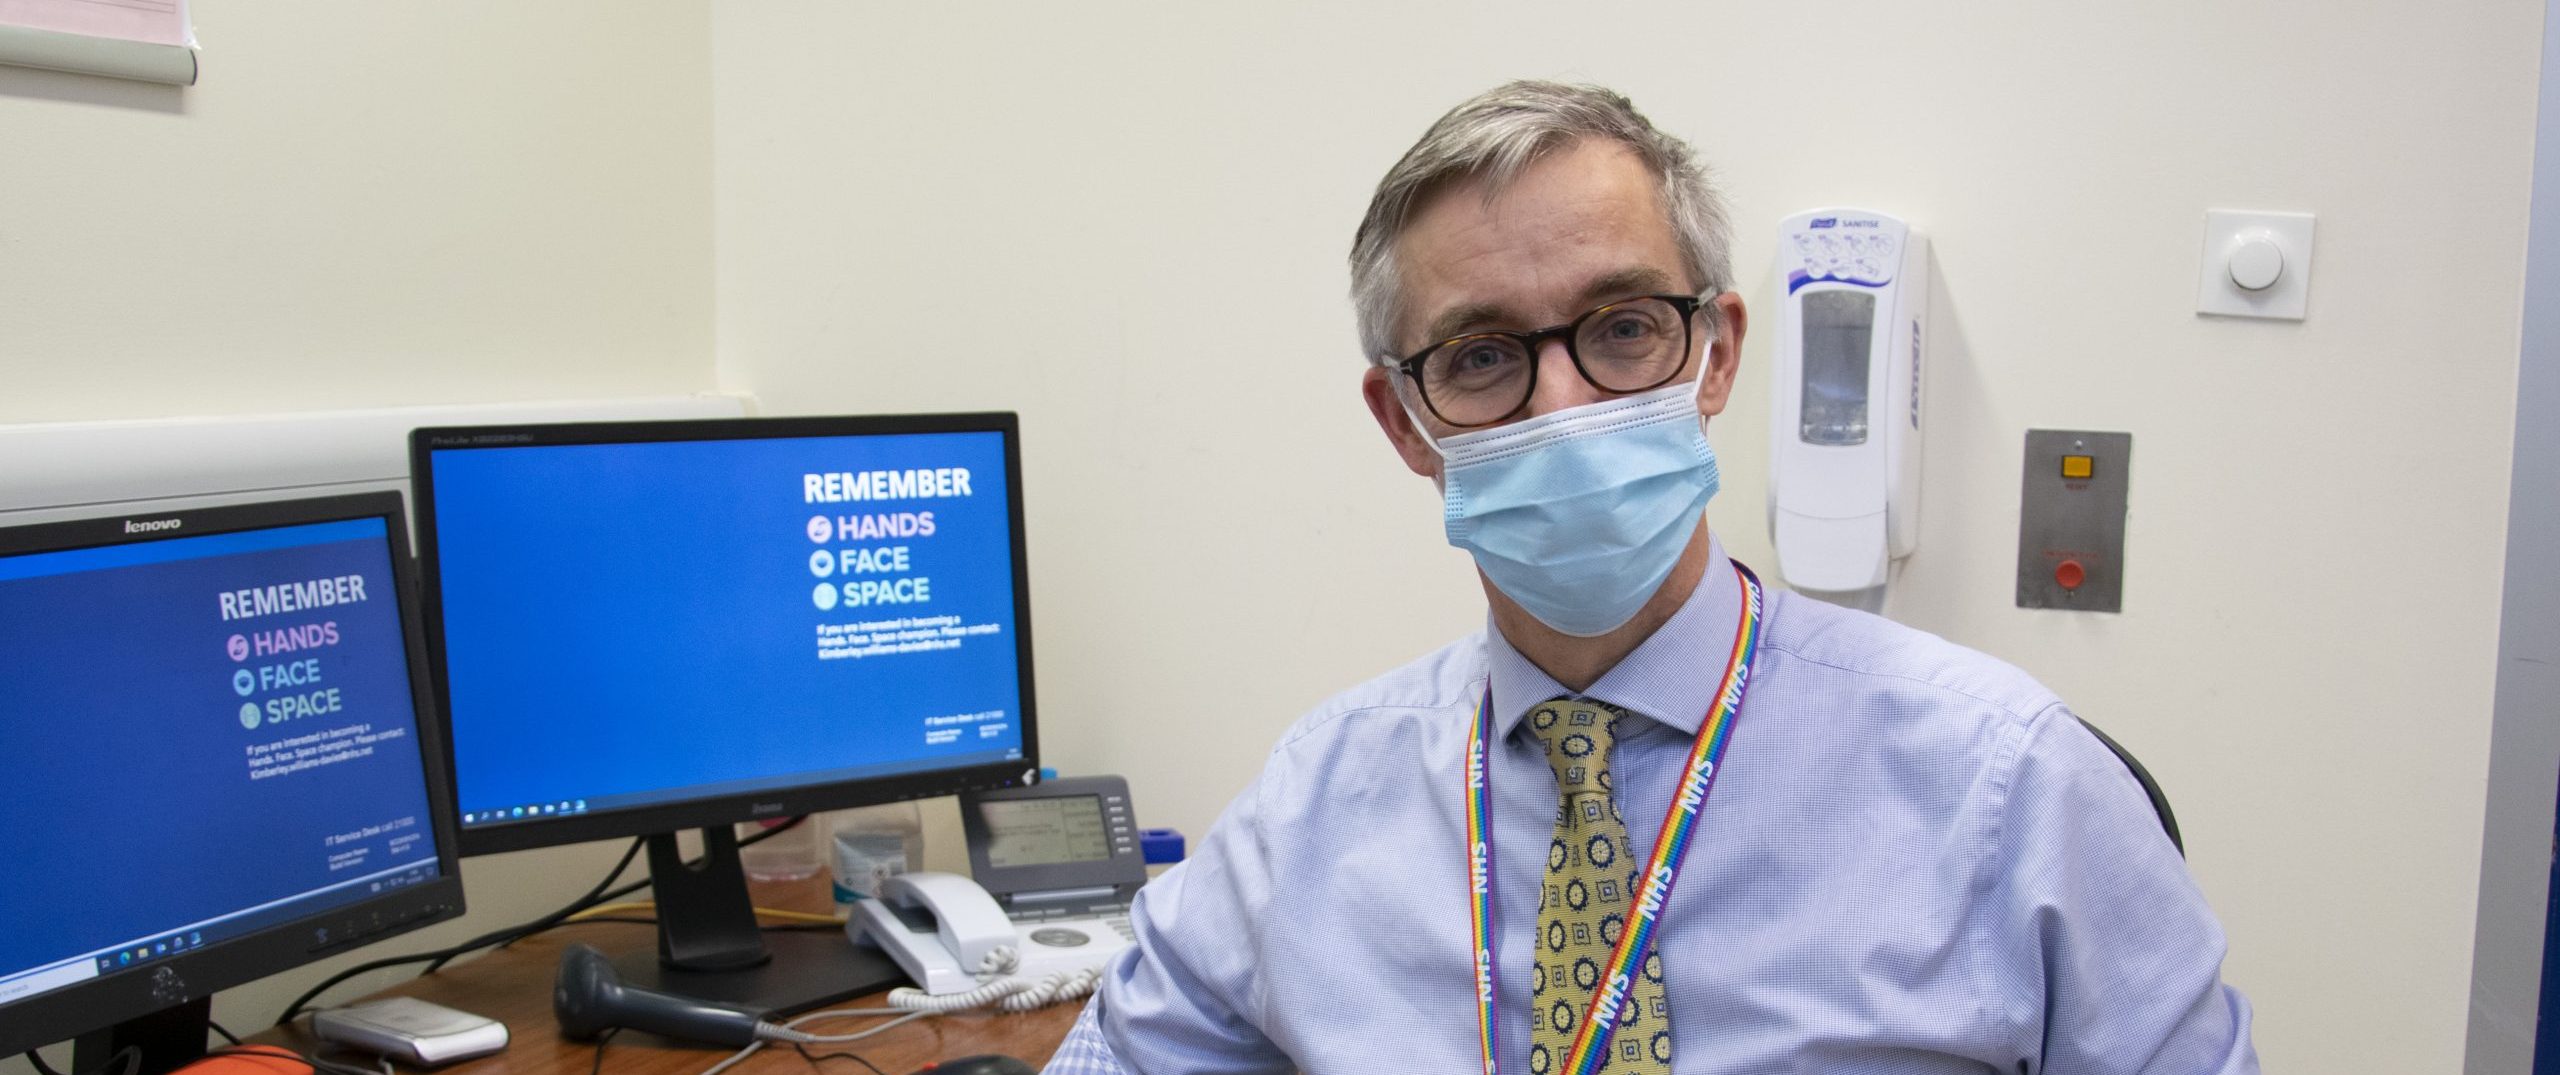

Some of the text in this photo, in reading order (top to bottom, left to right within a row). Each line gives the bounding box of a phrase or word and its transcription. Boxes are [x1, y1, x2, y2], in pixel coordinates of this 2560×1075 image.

[804, 467, 972, 503] REMEMBER
[124, 518, 182, 534] lenovo
[838, 511, 936, 540] HANDS
[840, 546, 910, 575] FACE
[219, 574, 367, 621] REMEMBER
[843, 577, 930, 607] SPACE
[255, 622, 340, 657] HANDS
[825, 624, 843, 637] you
[260, 658, 322, 692] FACE
[1720, 658, 1748, 714] NHS
[266, 688, 342, 725] SPACE
[246, 745, 254, 755] If
[254, 745, 269, 756] you
[270, 741, 283, 751] are
[283, 732, 320, 748] interested
[320, 731, 329, 740] in
[329, 724, 365, 738] becoming
[295, 747, 317, 759] Space
[355, 734, 377, 744] Please
[1468, 738, 1483, 789] NHS
[1678, 755, 1714, 815] NHS
[325, 836, 334, 847] IT
[334, 831, 362, 844] Service
[362, 825, 381, 838] Desk
[1471, 841, 1488, 893] NHS
[1637, 861, 1673, 922] NHS
[1476, 948, 1492, 1002] NHS
[1592, 968, 1630, 1030] NHS
